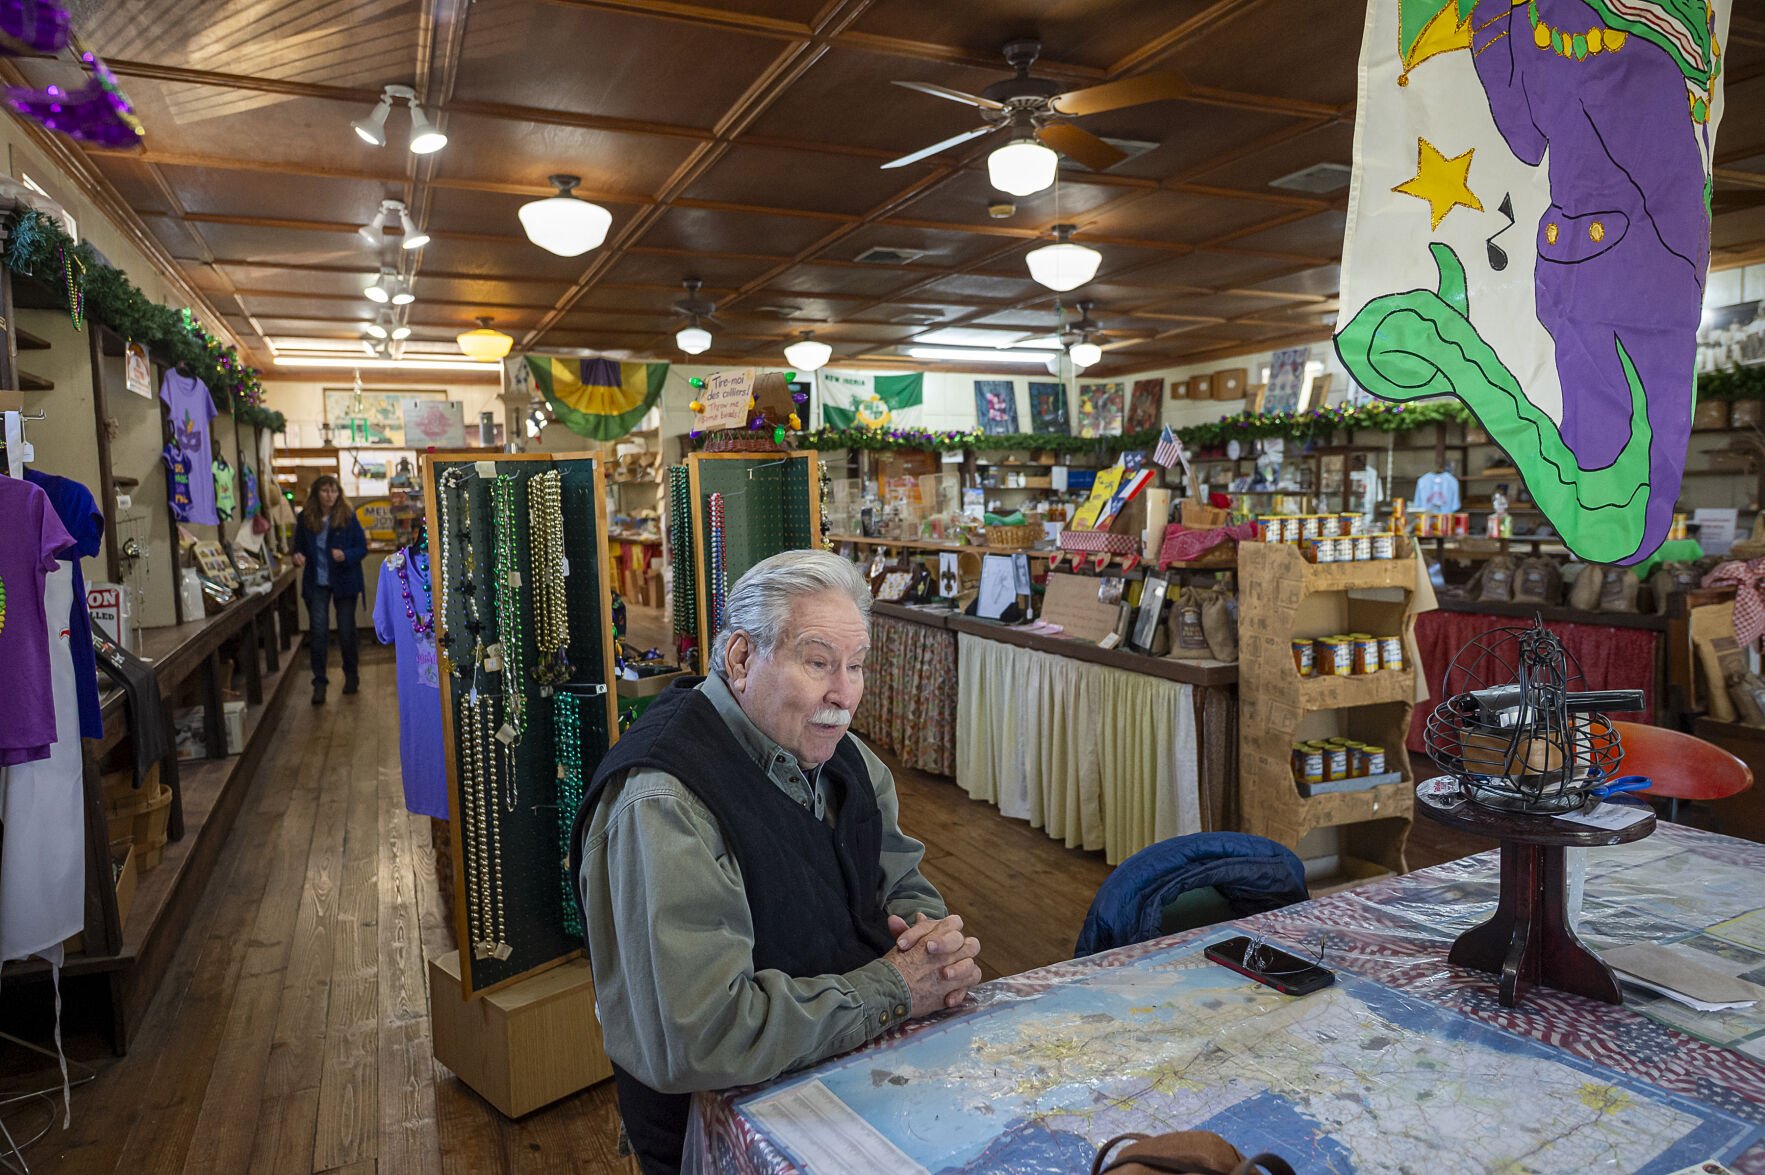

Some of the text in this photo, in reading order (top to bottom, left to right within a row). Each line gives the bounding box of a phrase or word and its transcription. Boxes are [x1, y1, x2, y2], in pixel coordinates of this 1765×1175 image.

[712, 373, 745, 389] Tire-moi
[707, 383, 751, 401] des colliers!
[364, 505, 391, 517] MELL
[87, 591, 117, 607] ON
[90, 611, 115, 620] LLED
